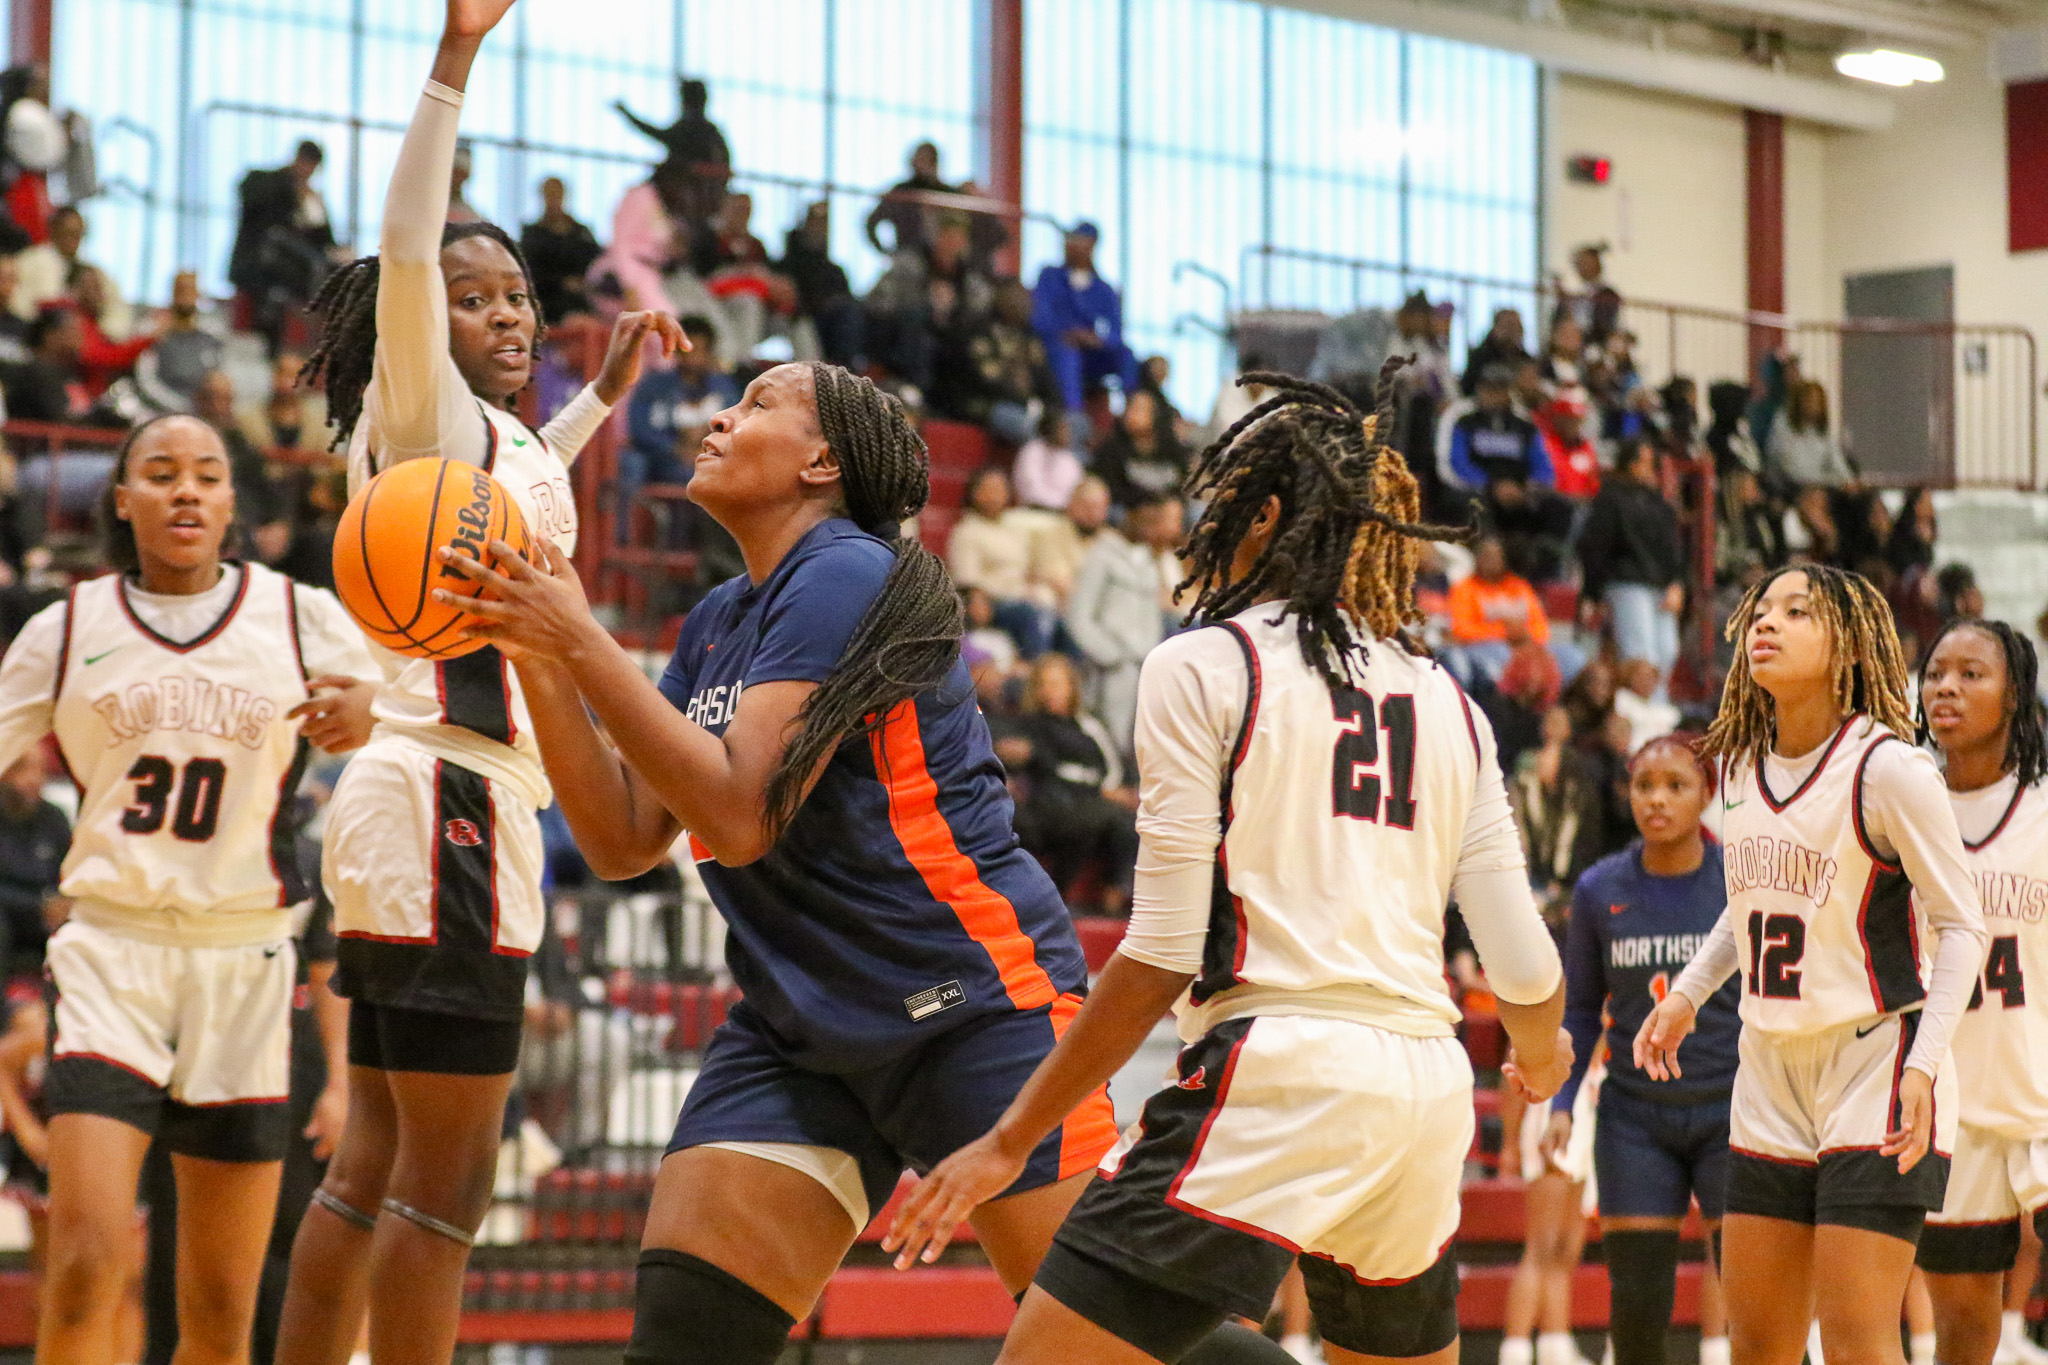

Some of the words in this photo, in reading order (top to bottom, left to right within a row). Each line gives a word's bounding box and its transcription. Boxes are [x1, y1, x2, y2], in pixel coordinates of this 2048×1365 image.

[92, 675, 277, 751] ROBINS
[1330, 682, 1417, 831] 21
[119, 754, 227, 843] 30
[1724, 836, 1838, 908] ROBINS
[1972, 870, 2048, 925] INS
[1748, 909, 1806, 1001] 12
[1966, 933, 2026, 1012] 4
[941, 988, 961, 1001] XXL
